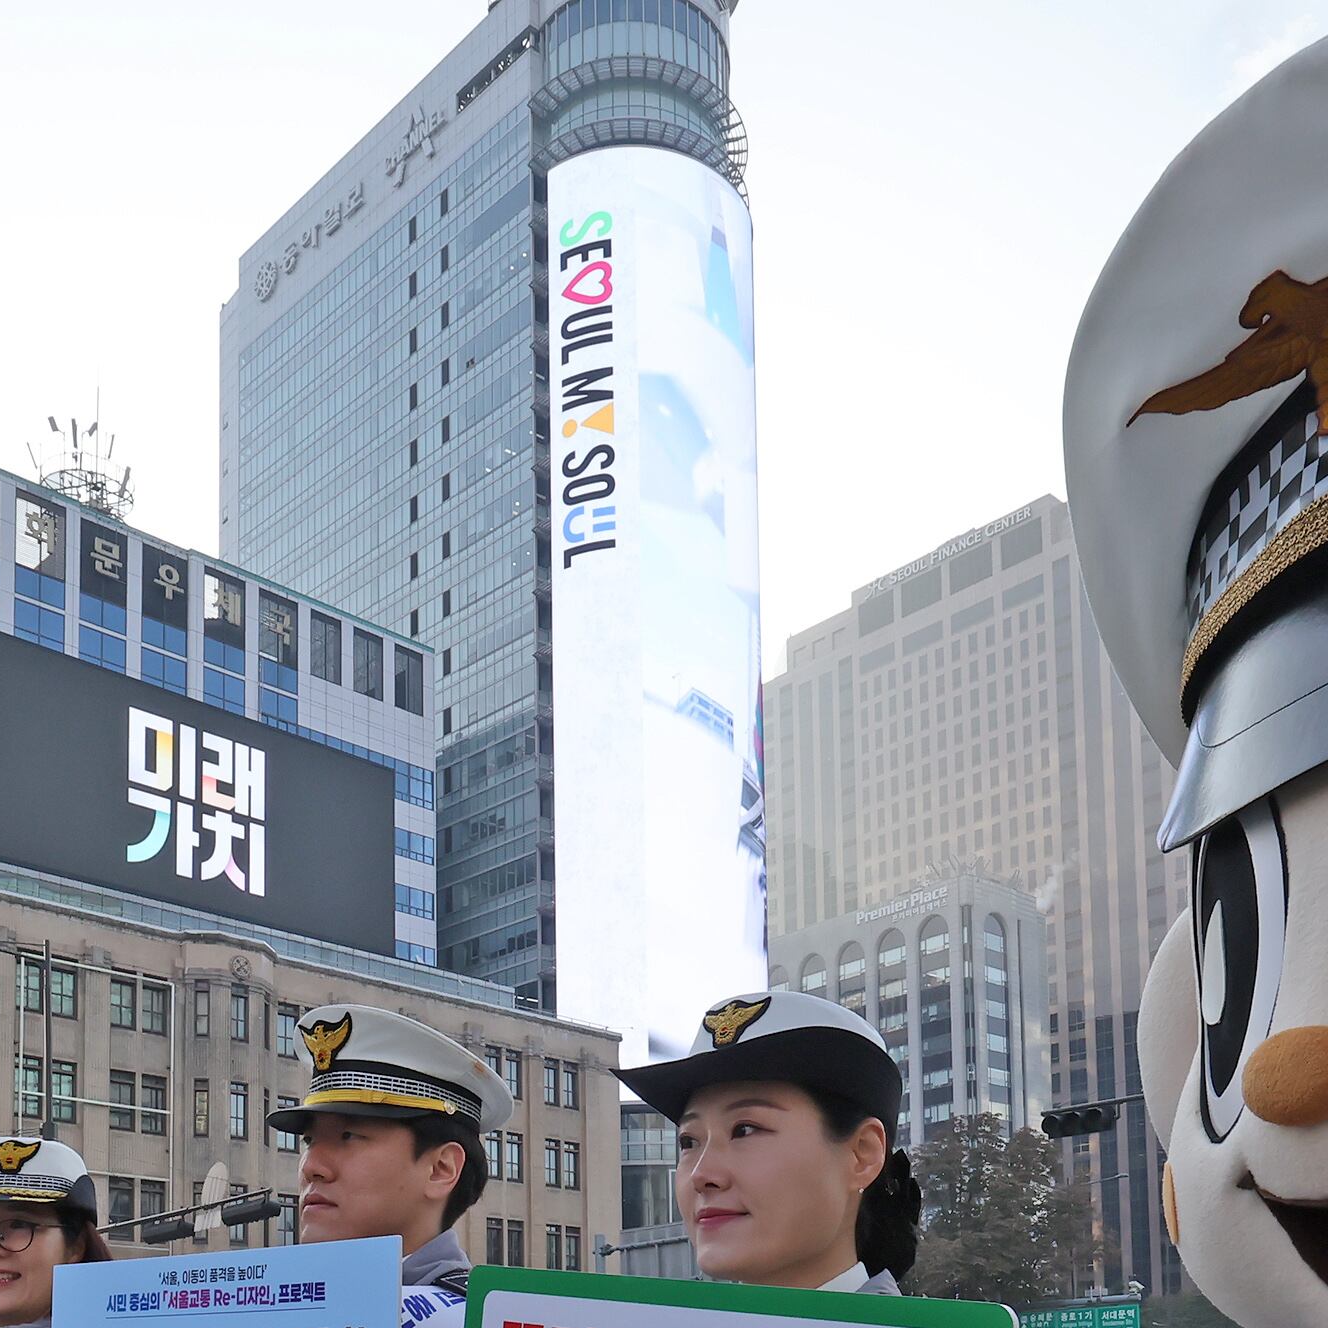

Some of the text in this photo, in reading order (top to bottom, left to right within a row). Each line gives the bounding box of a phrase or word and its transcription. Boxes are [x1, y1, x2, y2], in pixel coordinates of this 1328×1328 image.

[279, 182, 366, 275] 동아일보
[889, 506, 1032, 585] SEOUL FINANCE CENTER
[128, 706, 266, 820] 미래
[127, 796, 266, 897] 가치
[856, 886, 948, 925] Premier Place
[182, 1269, 208, 1285] 이동의
[209, 1266, 236, 1283] 품격을
[106, 1293, 127, 1313] 시민
[129, 1292, 161, 1311] 중심의
[278, 1281, 327, 1304] 프로젝트
[1060, 1311, 1092, 1322] 종로1가
[1101, 1309, 1135, 1320] 서대문역
